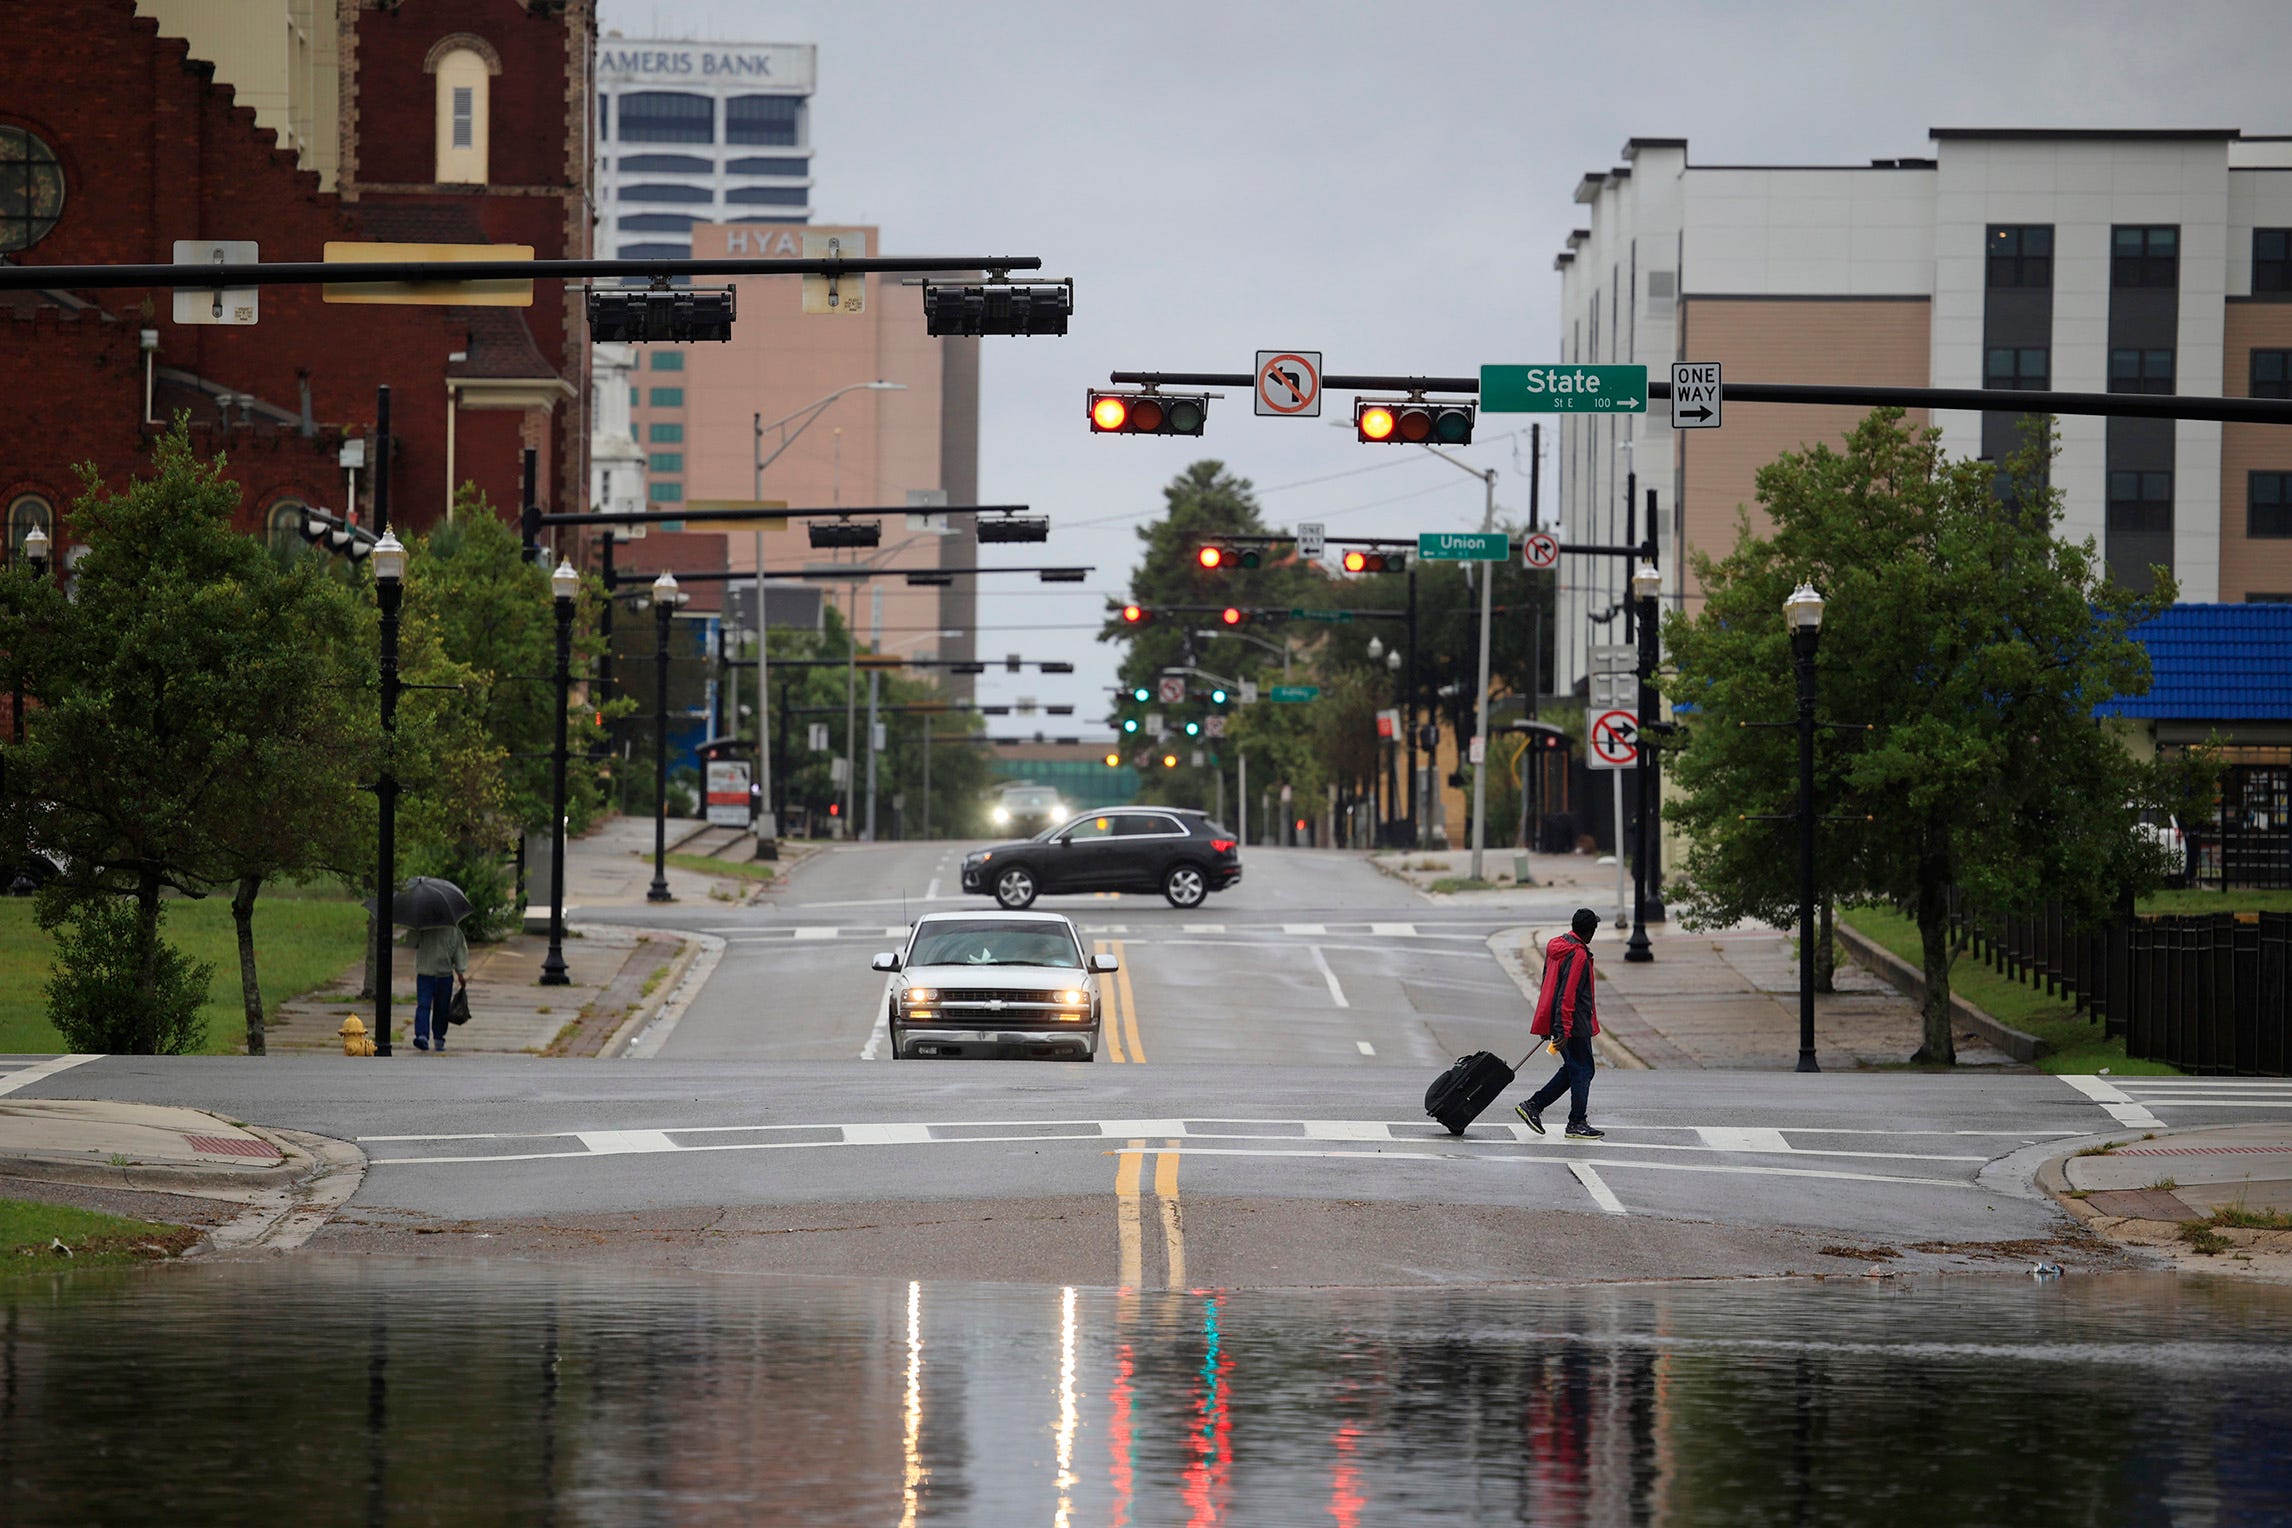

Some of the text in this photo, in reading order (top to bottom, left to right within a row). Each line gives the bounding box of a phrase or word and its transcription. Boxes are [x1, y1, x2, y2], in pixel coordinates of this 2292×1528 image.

[599, 51, 771, 76] AMERIS BANK
[726, 230, 803, 257] HYA
[1526, 369, 1600, 393] State
[1677, 367, 1715, 384] ONE
[1677, 386, 1717, 402] WAY
[1554, 398, 1611, 409] St E 100
[1440, 535, 1486, 549] Union
